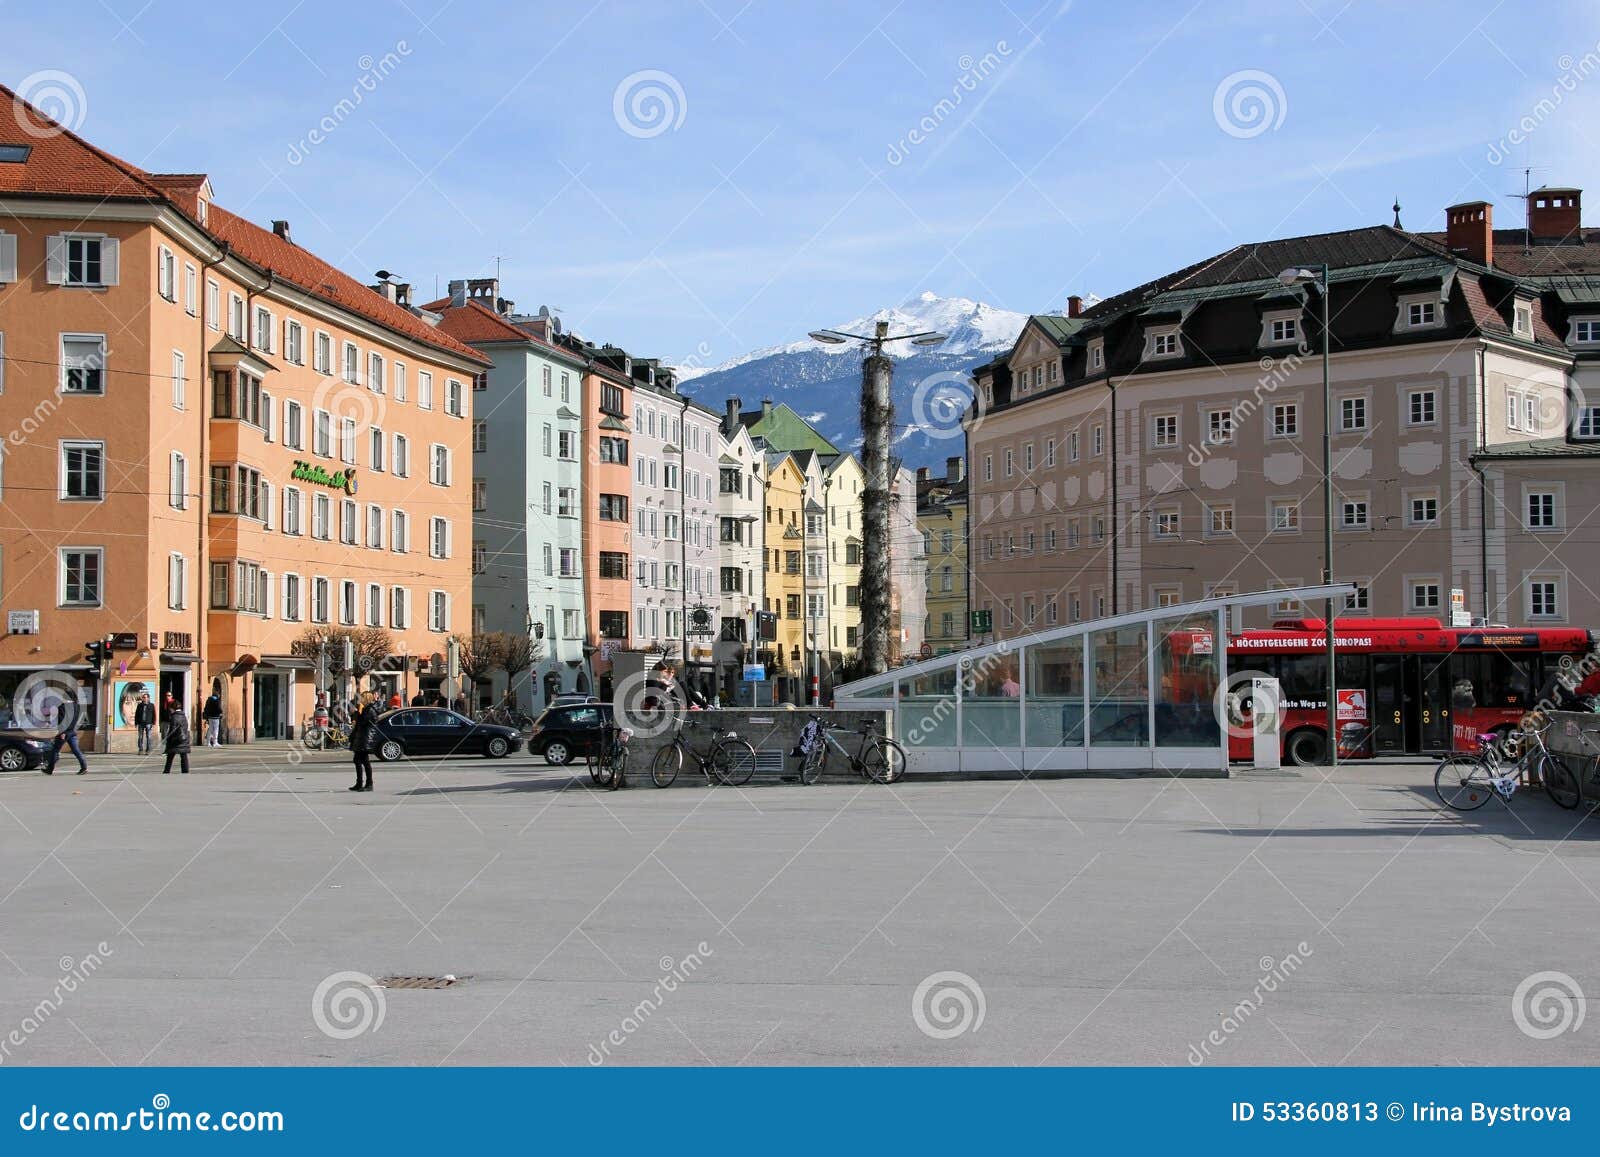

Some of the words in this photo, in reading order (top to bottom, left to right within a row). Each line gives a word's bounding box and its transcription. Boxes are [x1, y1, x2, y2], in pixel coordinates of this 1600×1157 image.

[1236, 637, 1308, 648] HÖCHSTGELEGENE
[1255, 680, 1262, 689] P
[1300, 700, 1316, 709] Weg
